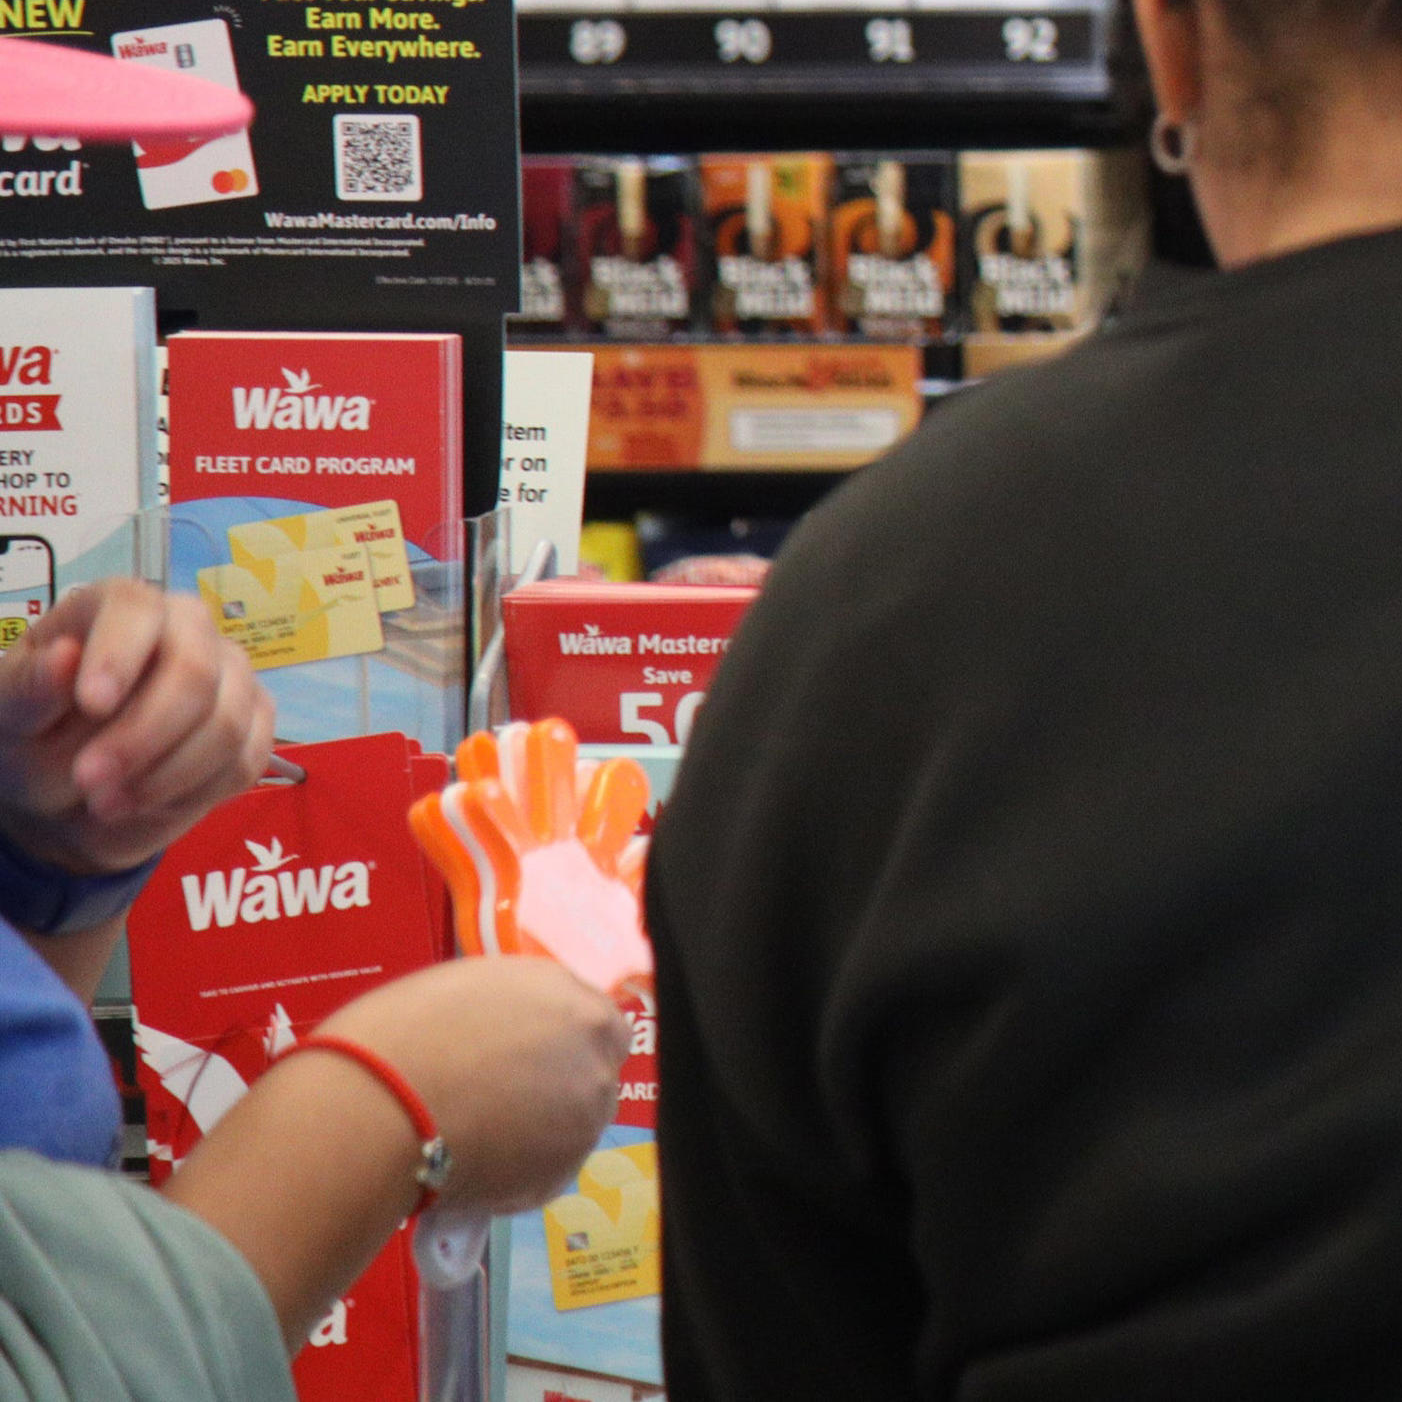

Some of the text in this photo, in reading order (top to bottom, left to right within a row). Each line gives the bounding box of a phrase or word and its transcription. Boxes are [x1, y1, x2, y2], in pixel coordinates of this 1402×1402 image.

[305, 7, 441, 30] Earn More.
[267, 35, 482, 64] Earn Everywhere.
[569, 20, 626, 65] 89
[864, 18, 914, 63] 91
[1001, 17, 1058, 63] 92
[302, 85, 449, 105] APPLY TODAY
[264, 212, 497, 232] WawaMastercard.com/Info
[231, 386, 371, 431] Wawa
[195, 456, 415, 476] FLEET CARD PROGRAM
[521, 456, 547, 473] on
[44, 473, 70, 488] TO
[518, 485, 548, 503] for
[559, 632, 632, 656] Wawa
[643, 665, 693, 686] Save
[182, 861, 371, 931] Wawa
